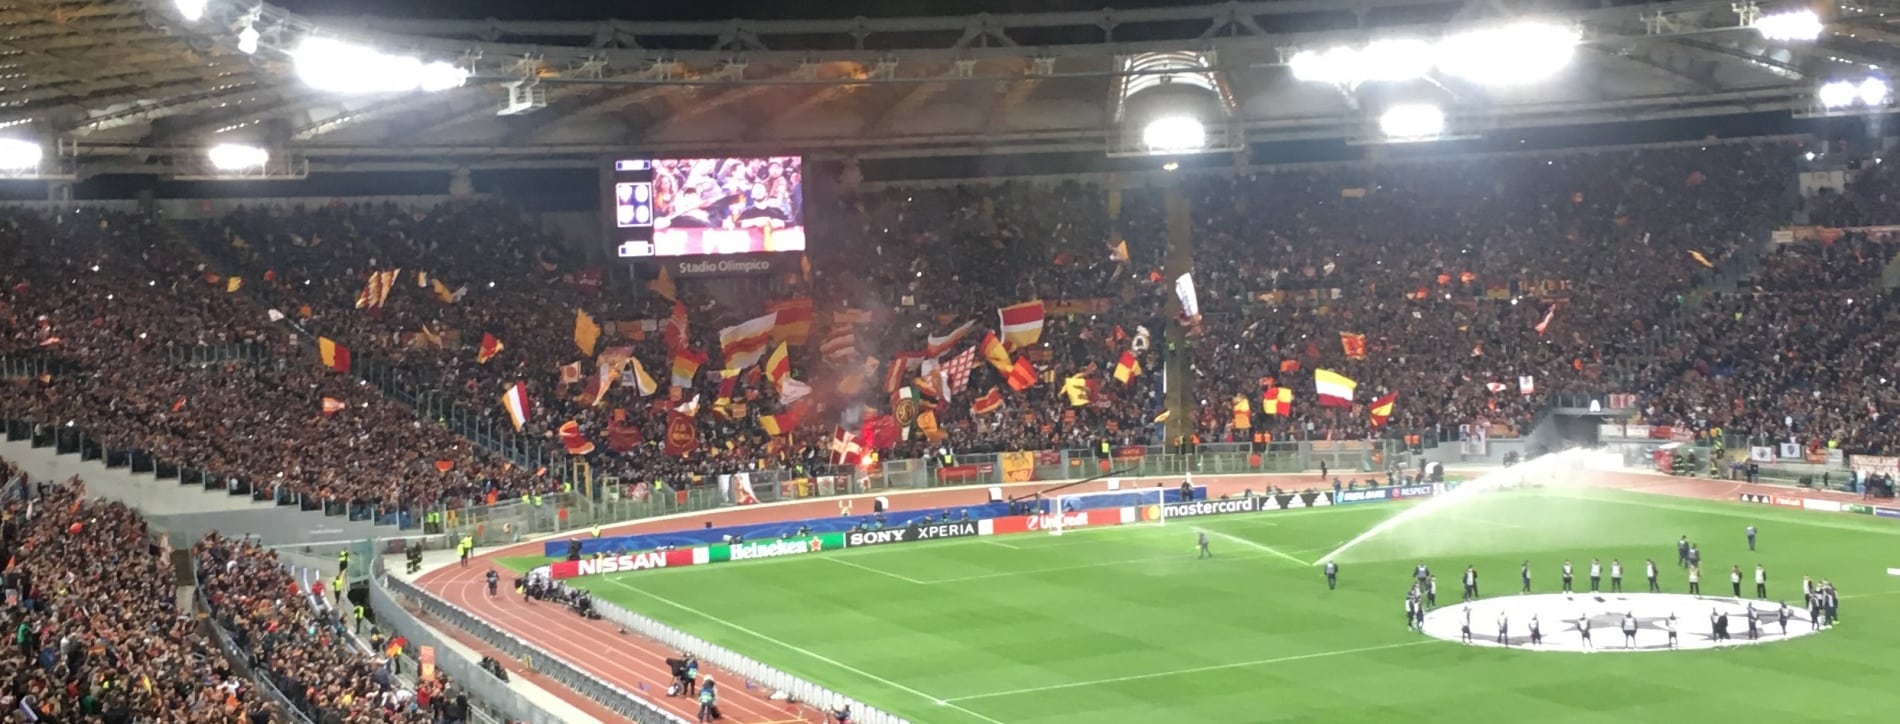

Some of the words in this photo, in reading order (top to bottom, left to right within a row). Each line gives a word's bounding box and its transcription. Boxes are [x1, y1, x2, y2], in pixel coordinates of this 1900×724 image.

[679, 260, 717, 274] Stadio
[718, 258, 770, 273] Olimpico
[1401, 486, 1431, 496] RESPECT
[1164, 497, 1252, 518] mastercard
[850, 529, 906, 545] SONY
[918, 523, 975, 539] XPERIA
[729, 538, 808, 561] Heineken
[578, 551, 667, 576] NISSAN
